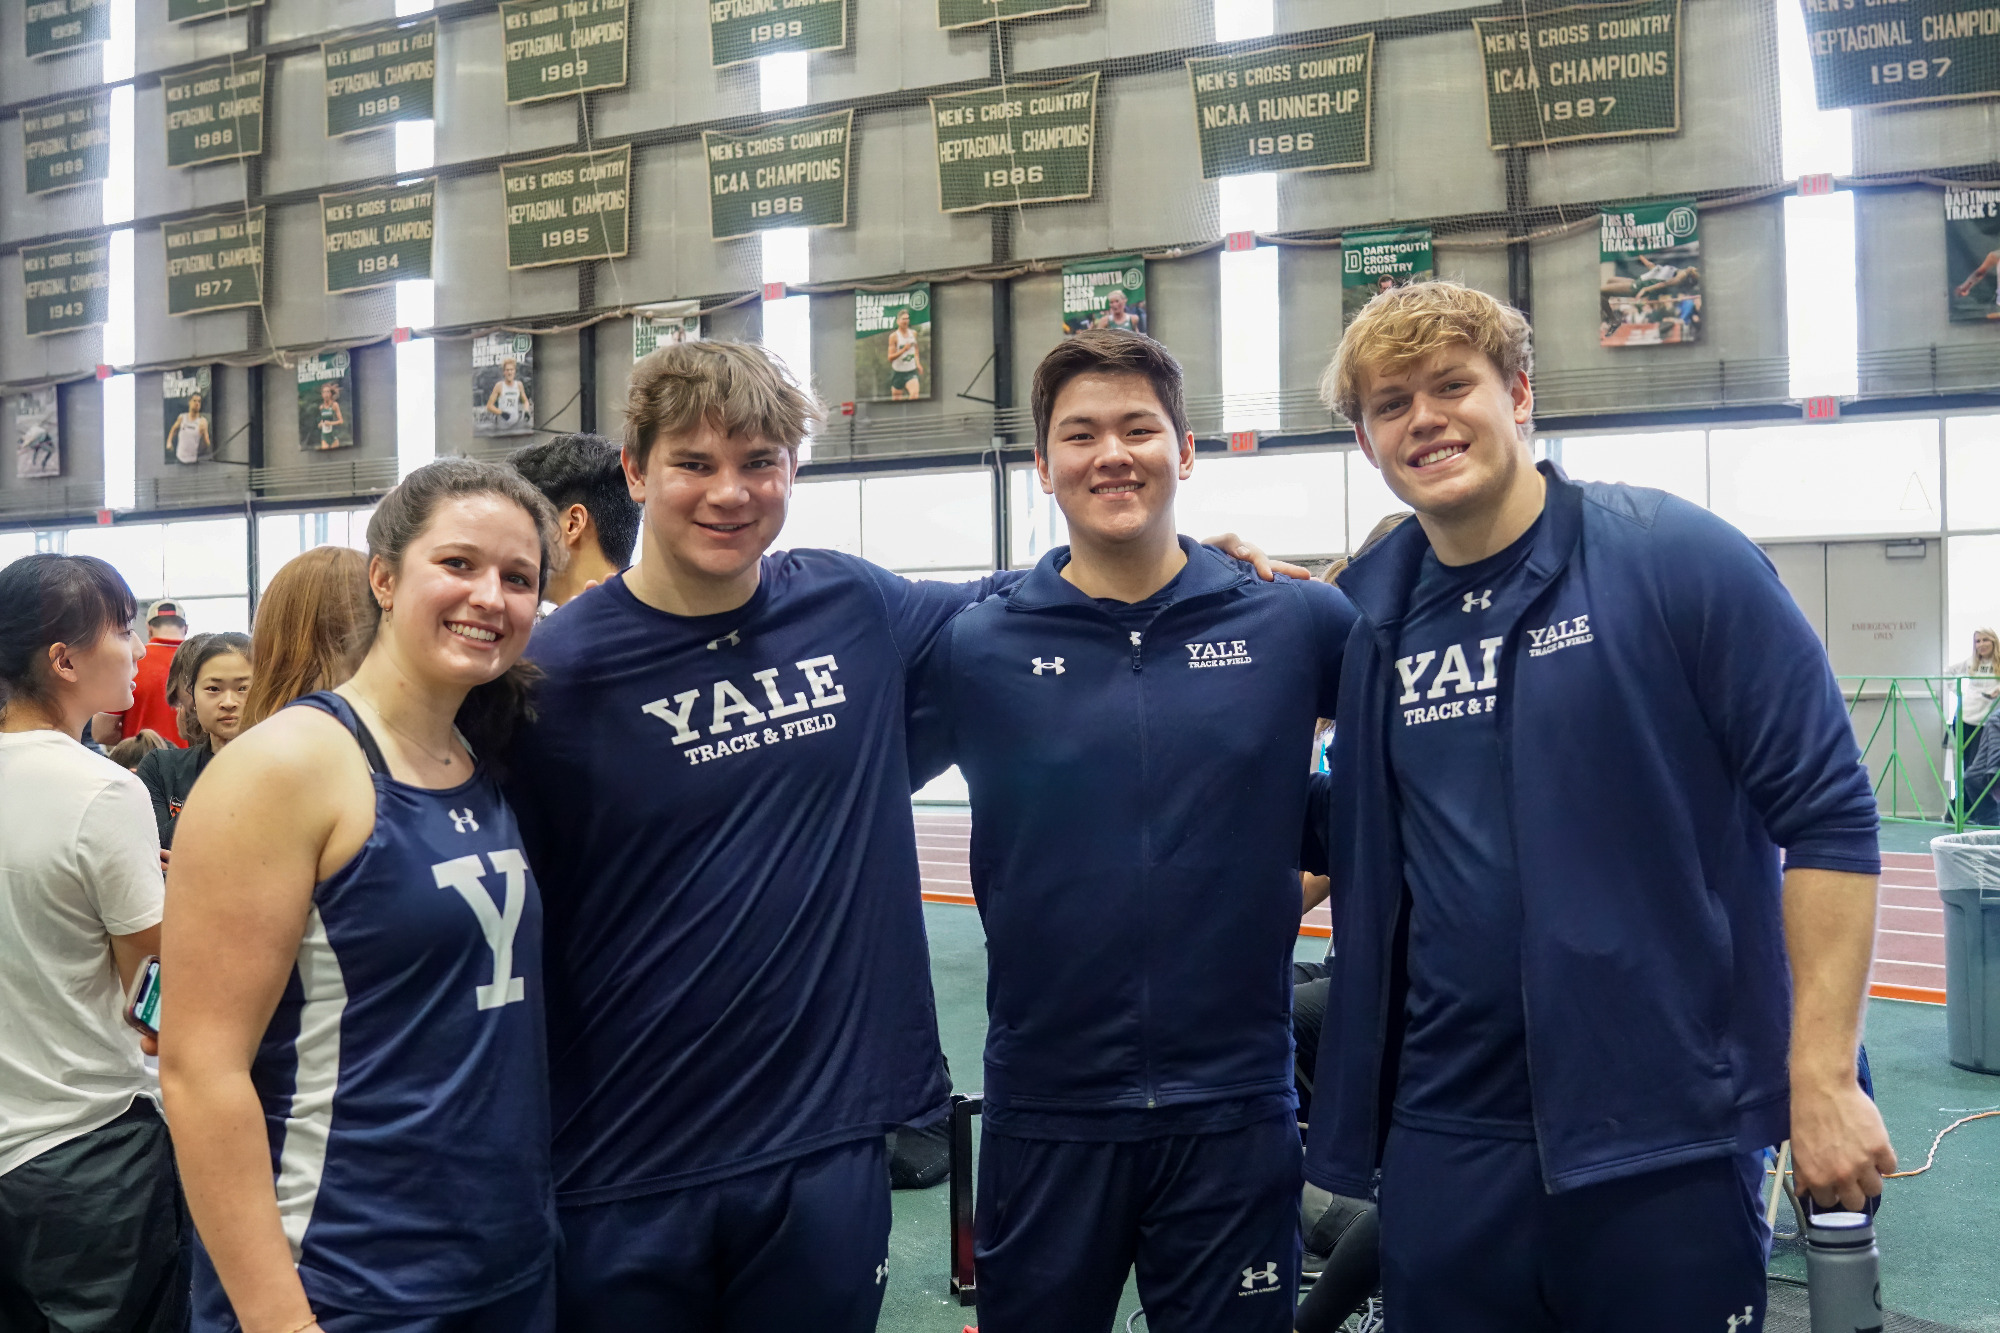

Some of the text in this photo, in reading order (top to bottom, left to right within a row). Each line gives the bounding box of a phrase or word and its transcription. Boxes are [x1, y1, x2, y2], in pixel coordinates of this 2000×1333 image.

[506, 12, 528, 30] MEN'S
[750, 20, 803, 43] 1989
[507, 21, 624, 62] HEPTAGONAL CHAMPIONS
[1484, 14, 1672, 54] MEN'S CROSS COUNTRY
[1812, 20, 1912, 56] HEPTAGONAL
[327, 59, 434, 97] HEPTAGONAL CHAMPIONS
[541, 60, 588, 82] 1989
[1196, 53, 1365, 92] MEN'S CROSS COUNTRY
[1493, 51, 1668, 93] IC4A CHAMPIONS
[1871, 57, 1952, 84] 1987
[219, 96, 262, 120] CHAMPIONS
[358, 95, 400, 117] 1988
[938, 91, 1090, 128] MEN'S CROSS COUNTRY
[1203, 89, 1360, 129] NCAA RUNNER-UP
[1543, 96, 1617, 121] 1987
[194, 128, 233, 149] 1988
[710, 127, 845, 162] MEN'S CROSS COUNTRY
[939, 124, 1090, 163] HEPTAGONAL CHAMPIONS
[1248, 132, 1315, 156] 1986
[507, 160, 625, 193] MEN'S CROSS COUNTRY
[714, 157, 841, 195] IC4A CHAMPIONS
[983, 165, 1044, 188] 1986
[1803, 176, 1829, 195] EXIT
[325, 192, 433, 222] MEN'S CROSS COUNTRY
[508, 189, 625, 225] HEPTAGONAL CHAMPIONS
[751, 196, 804, 218] 1986
[1946, 203, 1985, 220] TRACK
[1601, 222, 1665, 239] DARTMOUTH
[1623, 213, 1635, 226] IS
[327, 219, 432, 253] HEPTAGONAL CHAMPIONS
[542, 227, 590, 248] 1985
[1602, 236, 1635, 252] TRACK
[1647, 234, 1675, 250] FIELD
[1363, 242, 1429, 256] DARTMOUTH
[1363, 254, 1397, 266] CROSS
[358, 253, 400, 274] 1984
[1364, 262, 1413, 275] COUNTRY
[195, 279, 233, 298] 1977
[1063, 271, 1122, 288] DARTMOUTH
[856, 293, 910, 308] DARTMOUTH
[1063, 286, 1095, 300] CROSS
[49, 301, 83, 319] 1943
[856, 306, 884, 319] CROSS
[1063, 296, 1107, 313] COUNTRY
[856, 317, 896, 331] COUNTRY
[1809, 397, 1835, 418] EXIT
[1526, 614, 1590, 648] YALE
[1851, 622, 1898, 631] EMERGENCY
[1185, 640, 1248, 660] YALE
[1529, 643, 1558, 658] TRACK
[1565, 633, 1595, 647] FIELD
[1188, 657, 1253, 669] TRACK & FIELD
[641, 655, 846, 745] YALE
[1404, 701, 1464, 726] TRACK
[1467, 698, 1481, 715] &
[684, 713, 837, 765] TRACK & FIELD
[431, 849, 529, 1011] Y
